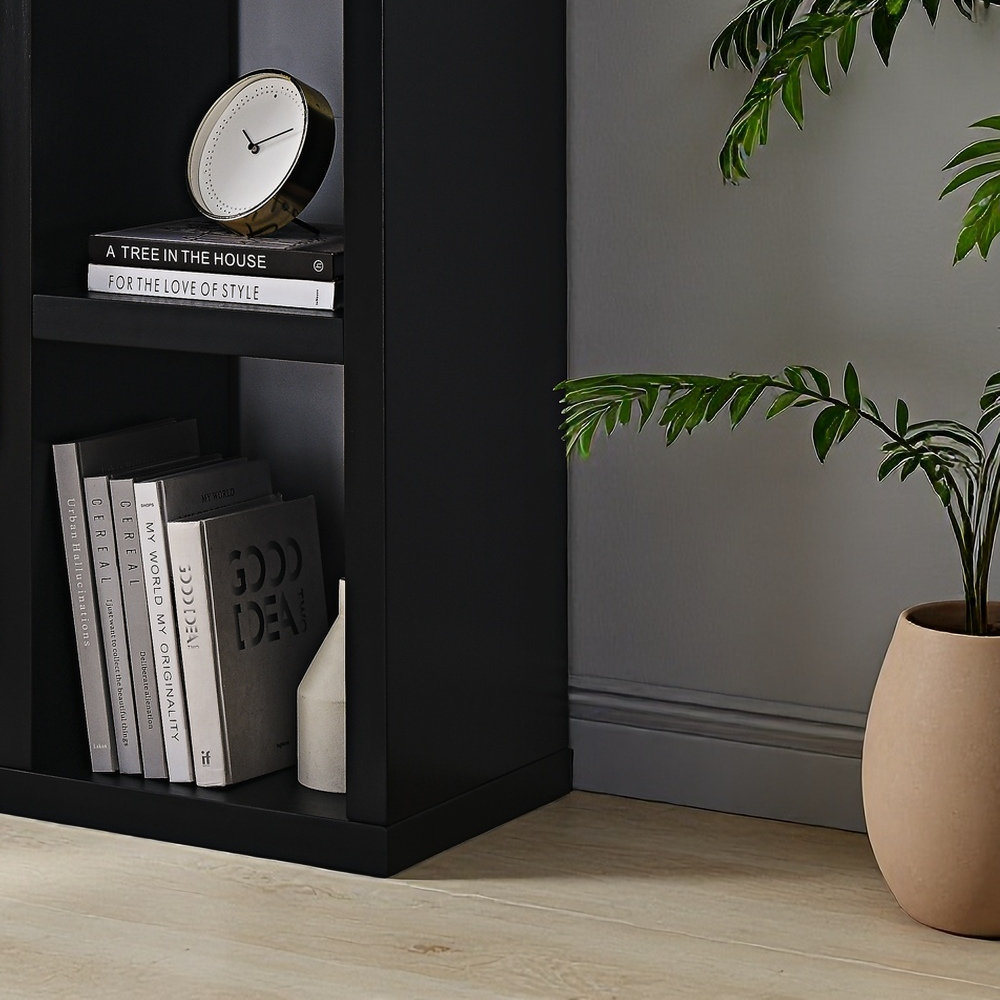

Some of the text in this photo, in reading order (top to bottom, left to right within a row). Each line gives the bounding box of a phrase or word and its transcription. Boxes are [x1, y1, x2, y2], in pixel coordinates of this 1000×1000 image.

[105, 245, 267, 269] A TREE IN THE HOUSE
[108, 274, 260, 301] FOR THE LOVE OF STYLE
[91, 498, 112, 583] CEREAL
[120, 500, 140, 586] CEREAL
[67, 498, 91, 647] Urban Hallucinations
[178, 564, 195, 606] GOOD
[229, 536, 303, 596] GOOD
[145, 522, 180, 742] MY WORLD MY ORIGINALITY
[183, 608, 199, 644] IDEA
[232, 591, 300, 650] IDEA
[140, 651, 149, 692] Deliberate
[117, 687, 127, 721] beautiful
